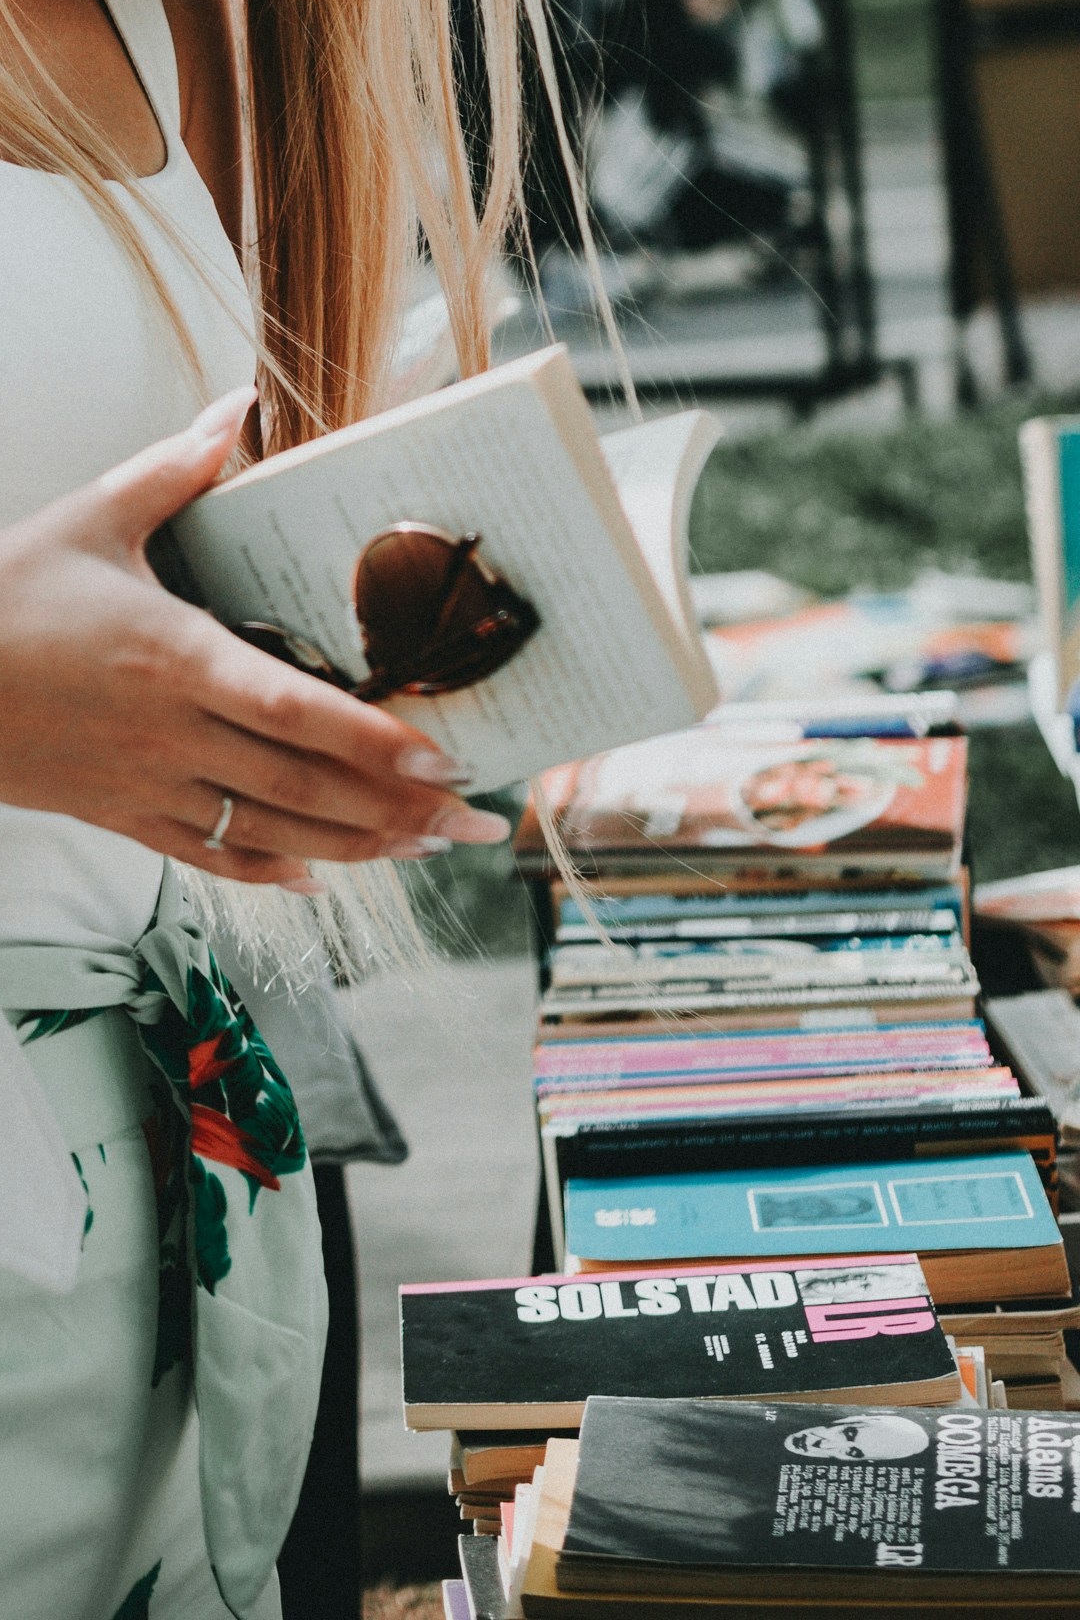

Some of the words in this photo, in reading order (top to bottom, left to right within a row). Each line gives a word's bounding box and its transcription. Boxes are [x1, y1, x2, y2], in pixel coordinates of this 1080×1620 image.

[514, 1271, 799, 1323] SOLSTAD
[804, 1297, 936, 1343] LR
[781, 1331, 798, 1358] SOLSTAD
[933, 1414, 982, 1510] OOMEGA
[1027, 1416, 1072, 1498] Adams
[875, 1543, 924, 1567] LR
